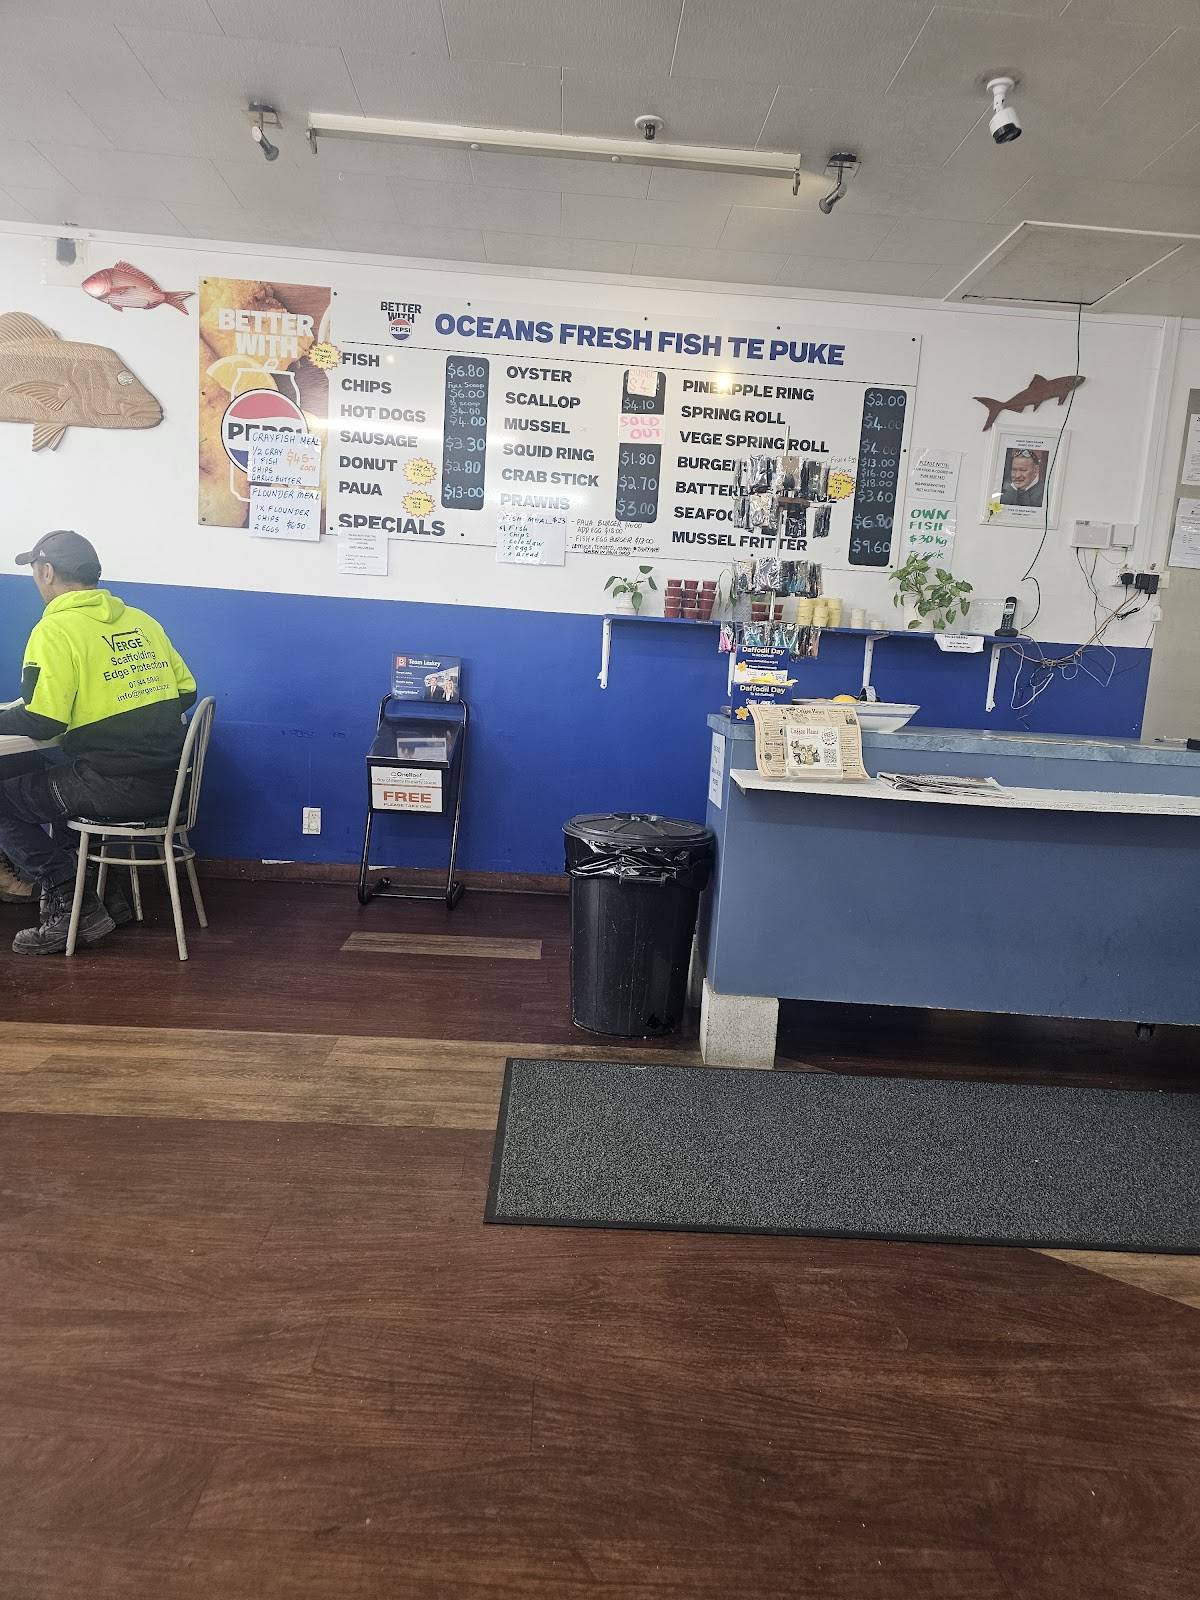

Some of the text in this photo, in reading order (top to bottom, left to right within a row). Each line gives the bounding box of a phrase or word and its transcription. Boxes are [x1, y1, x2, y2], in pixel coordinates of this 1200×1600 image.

[381, 301, 422, 314] BETTER
[218, 307, 315, 337] BETTER
[387, 312, 416, 324] WITH
[390, 326, 411, 334] PEPSI
[235, 332, 299, 359] WITH
[435, 313, 846, 366] OCEANS FRESH FISH TE PUKE
[342, 352, 380, 367] FISH
[447, 363, 485, 378] $6.80
[506, 365, 572, 383] OYSTER
[341, 378, 392, 394] CHIPS
[776, 386, 815, 401] RING
[449, 389, 485, 401] $6.00
[505, 391, 581, 409] SCALLOP
[867, 393, 905, 408] $2.00
[624, 398, 655, 411] $4.10
[340, 404, 426, 423] HOT DOGS
[620, 415, 660, 427] SOLD
[681, 405, 786, 425] SPRING ROLL
[504, 417, 570, 434] MUSSEL
[252, 432, 296, 445] CRAYFISH
[299, 435, 320, 446] MEAL
[339, 430, 418, 448] SAUSAGE
[630, 428, 661, 440] OUT
[680, 430, 829, 453] VEGE SPRING ROLL
[445, 435, 485, 451] $3.30
[264, 447, 284, 456] CRAY
[503, 443, 595, 462] SQUID RING
[620, 450, 656, 467] $1.80
[339, 455, 398, 471] DONUT
[444, 460, 481, 474] $2.80
[677, 456, 736, 472] BURGE
[860, 456, 895, 468] $13.00
[252, 466, 273, 474] CHIPS
[501, 468, 600, 487] CRAB STICK
[861, 467, 894, 479] $16.00
[338, 481, 382, 496] PAUA
[618, 475, 657, 492] $2.70
[676, 481, 748, 497] BATTERE
[860, 478, 893, 488] $18.00
[252, 488, 320, 500] FLOUNDER MEAL
[500, 493, 570, 510] PRAWNS
[858, 489, 893, 503] $3.60
[268, 505, 310, 517] FLOUNDER
[616, 498, 655, 517] $3.00
[674, 506, 734, 521] SEAFO
[910, 508, 951, 520] OWN
[257, 514, 279, 523] CHIPS
[338, 514, 446, 536] SPECIALS
[853, 513, 893, 530] $6.80
[909, 521, 943, 531] FISH
[672, 531, 808, 552] MUSSEL FRITTER
[852, 538, 891, 554] $9.60
[909, 534, 934, 545] $30
[101, 630, 143, 653] VERGE
[111, 650, 156, 665] Scaffolding
[742, 646, 770, 654] Daffodil
[771, 648, 785, 656] Day
[104, 661, 169, 681] Edge Protection
[771, 687, 785, 695] Day
[383, 791, 432, 804] FREE
